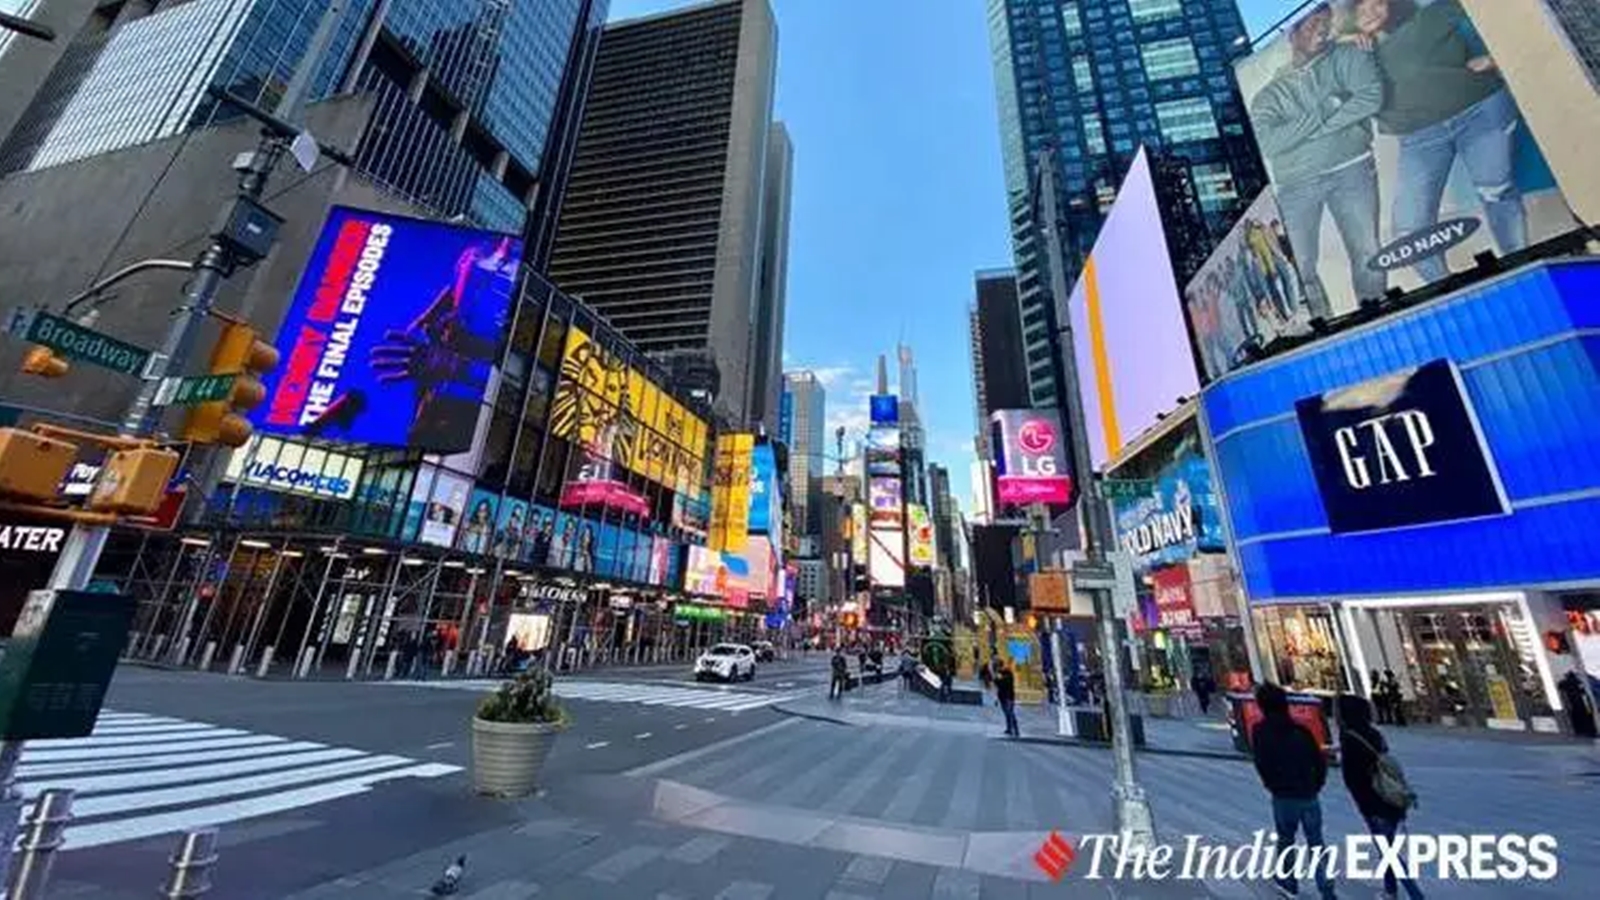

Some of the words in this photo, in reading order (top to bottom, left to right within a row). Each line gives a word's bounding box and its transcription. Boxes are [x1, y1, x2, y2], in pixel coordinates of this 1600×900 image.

[1377, 241, 1412, 269] OLD
[1414, 220, 1467, 254] NAVY
[38, 319, 145, 375] Broadway
[299, 375, 335, 427] THE
[317, 315, 358, 379] FINAL
[341, 221, 394, 315] EPISODES
[1021, 454, 1057, 477] LG
[1333, 408, 1438, 490] GAP
[1151, 504, 1194, 549] NAVY
